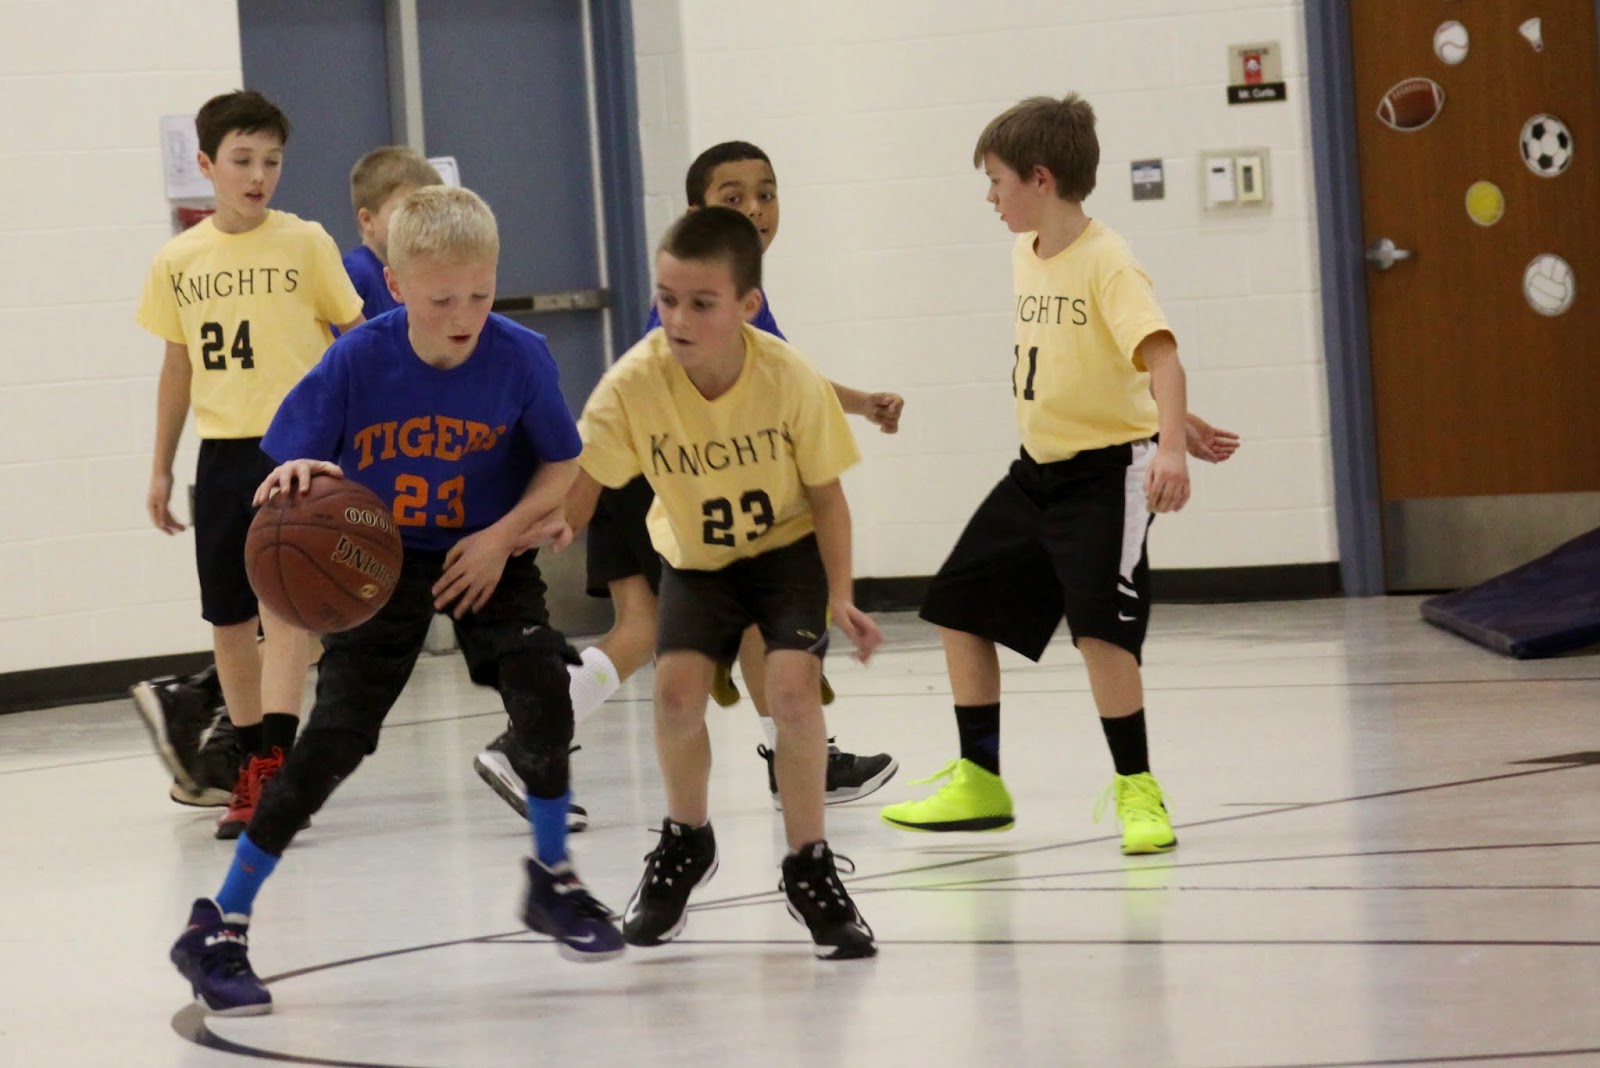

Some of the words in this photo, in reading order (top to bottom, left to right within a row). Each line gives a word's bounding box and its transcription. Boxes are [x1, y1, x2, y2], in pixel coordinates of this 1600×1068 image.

[170, 268, 299, 307] KNIGHTS
[200, 320, 255, 370] 24
[353, 414, 507, 471] TIGERS
[392, 473, 465, 528] 23
[702, 488, 776, 547] 23
